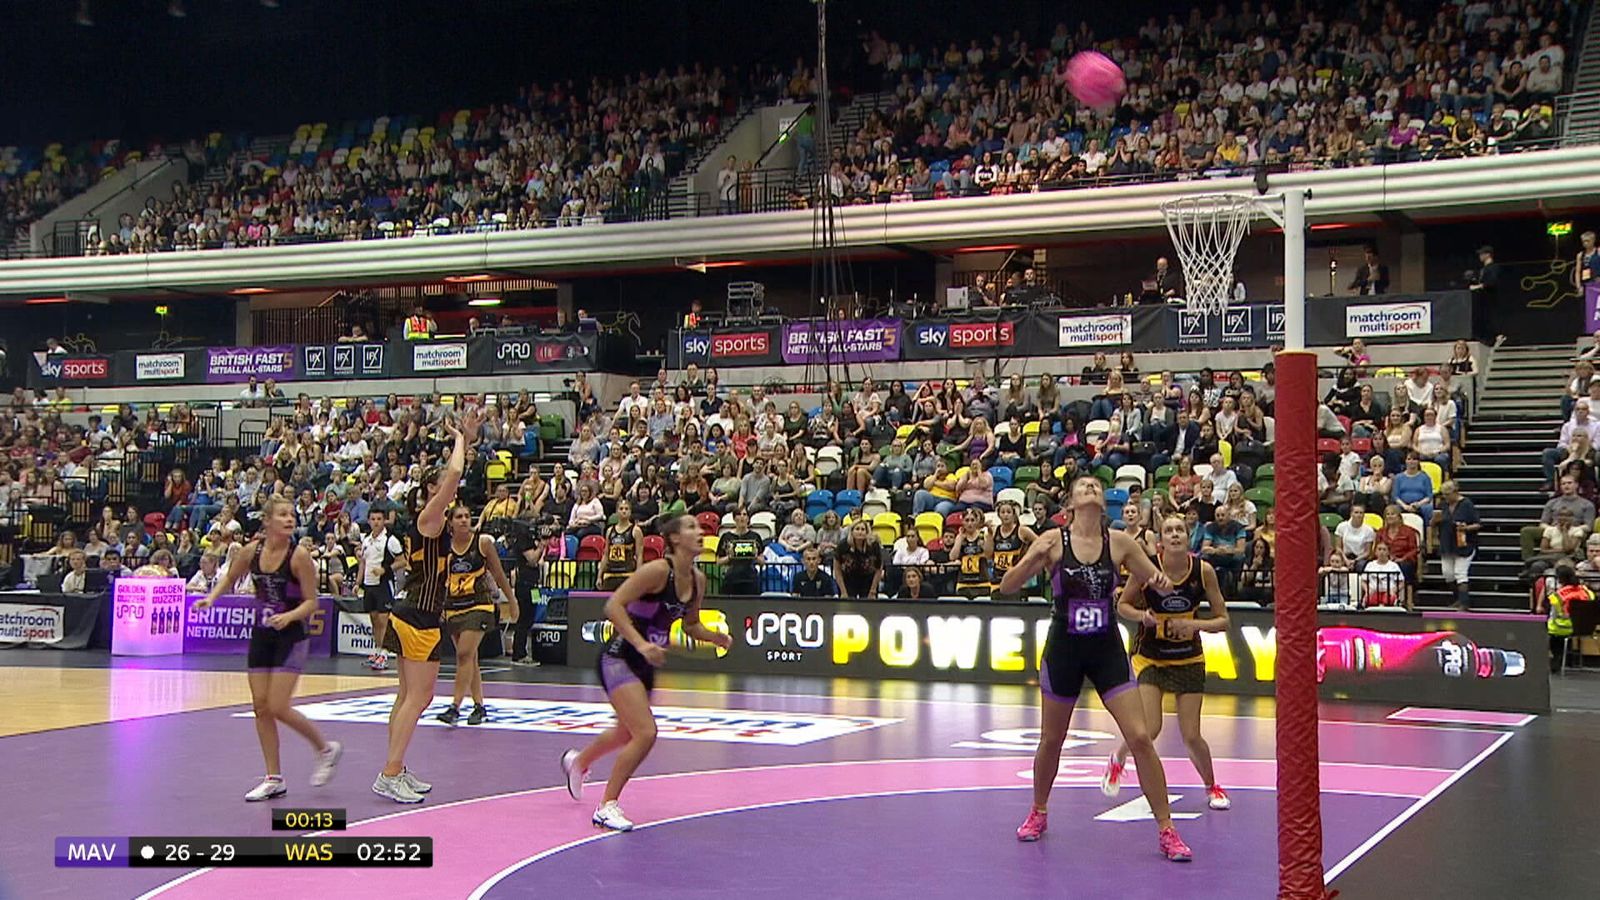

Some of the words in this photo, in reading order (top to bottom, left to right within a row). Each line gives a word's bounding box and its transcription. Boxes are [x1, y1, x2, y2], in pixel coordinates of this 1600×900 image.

[1183, 313, 1202, 334] IFX
[1227, 311, 1246, 333] IFX
[1349, 311, 1421, 327] matchroom
[1062, 321, 1124, 335] matchroom
[1359, 322, 1421, 336] multisport
[920, 327, 946, 346] sky
[952, 326, 1010, 346] sports
[1070, 332, 1123, 345] multisport
[685, 338, 710, 356] sky
[714, 337, 765, 355] sports
[210, 353, 252, 367] BRITISH
[416, 348, 461, 360] matchroom
[41, 361, 62, 377] sky
[64, 362, 104, 376] sports
[138, 358, 179, 368] matchroom
[422, 358, 460, 368] multisport
[144, 367, 179, 377] multisport
[117, 585, 146, 594] GOLDEN
[152, 585, 183, 594] GOLDEN
[151, 595, 183, 604] BUZZER
[187, 604, 256, 626] BRITISH
[186, 625, 237, 639] NETBALL
[767, 651, 802, 661] SPORT
